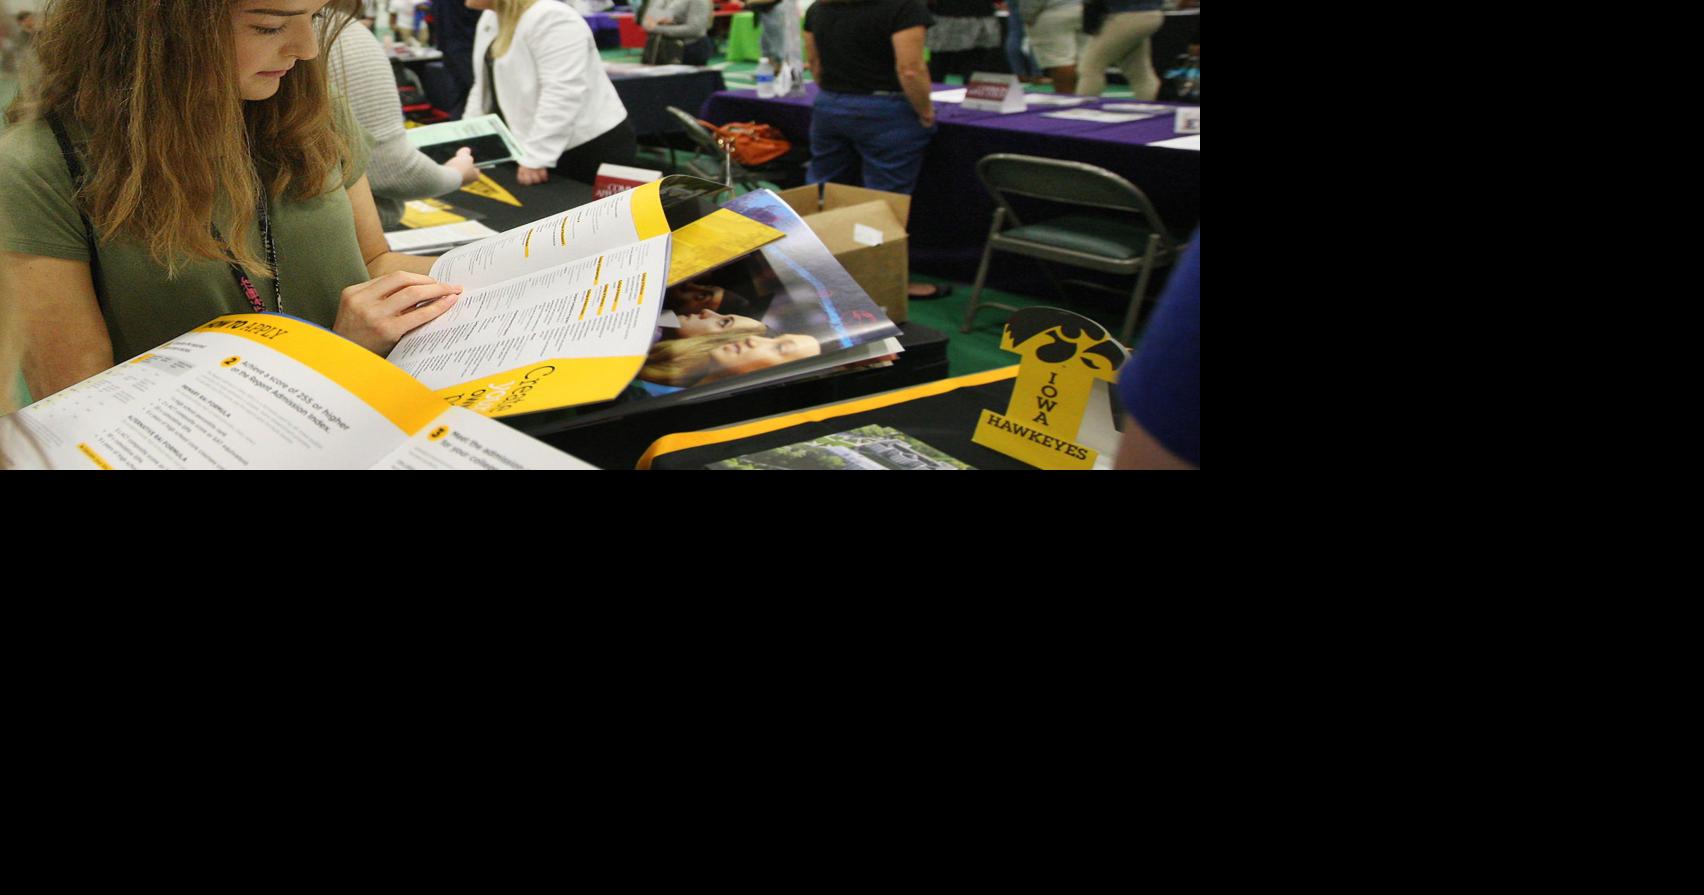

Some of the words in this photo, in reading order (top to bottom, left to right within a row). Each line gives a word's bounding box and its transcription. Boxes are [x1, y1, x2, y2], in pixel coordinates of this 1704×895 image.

[229, 320, 247, 330] TO
[240, 321, 288, 340] APPLY
[224, 357, 237, 365] 2
[241, 360, 265, 376] Achieve
[270, 375, 289, 389] score
[288, 385, 298, 394] of
[297, 391, 313, 405] 255
[313, 402, 322, 411] or
[322, 408, 350, 431] higher
[239, 368, 249, 379] the
[250, 375, 273, 393] Regent
[271, 389, 308, 417] Admission
[474, 380, 516, 411] you
[1033, 372, 1058, 426] IOWA
[208, 401, 231, 418] FORMULA
[162, 440, 188, 462] FORMULA
[431, 427, 446, 438] 3
[451, 431, 469, 442] Meet
[469, 437, 483, 450] the
[451, 445, 471, 457] your
[987, 414, 1089, 461] HAWKEYES
